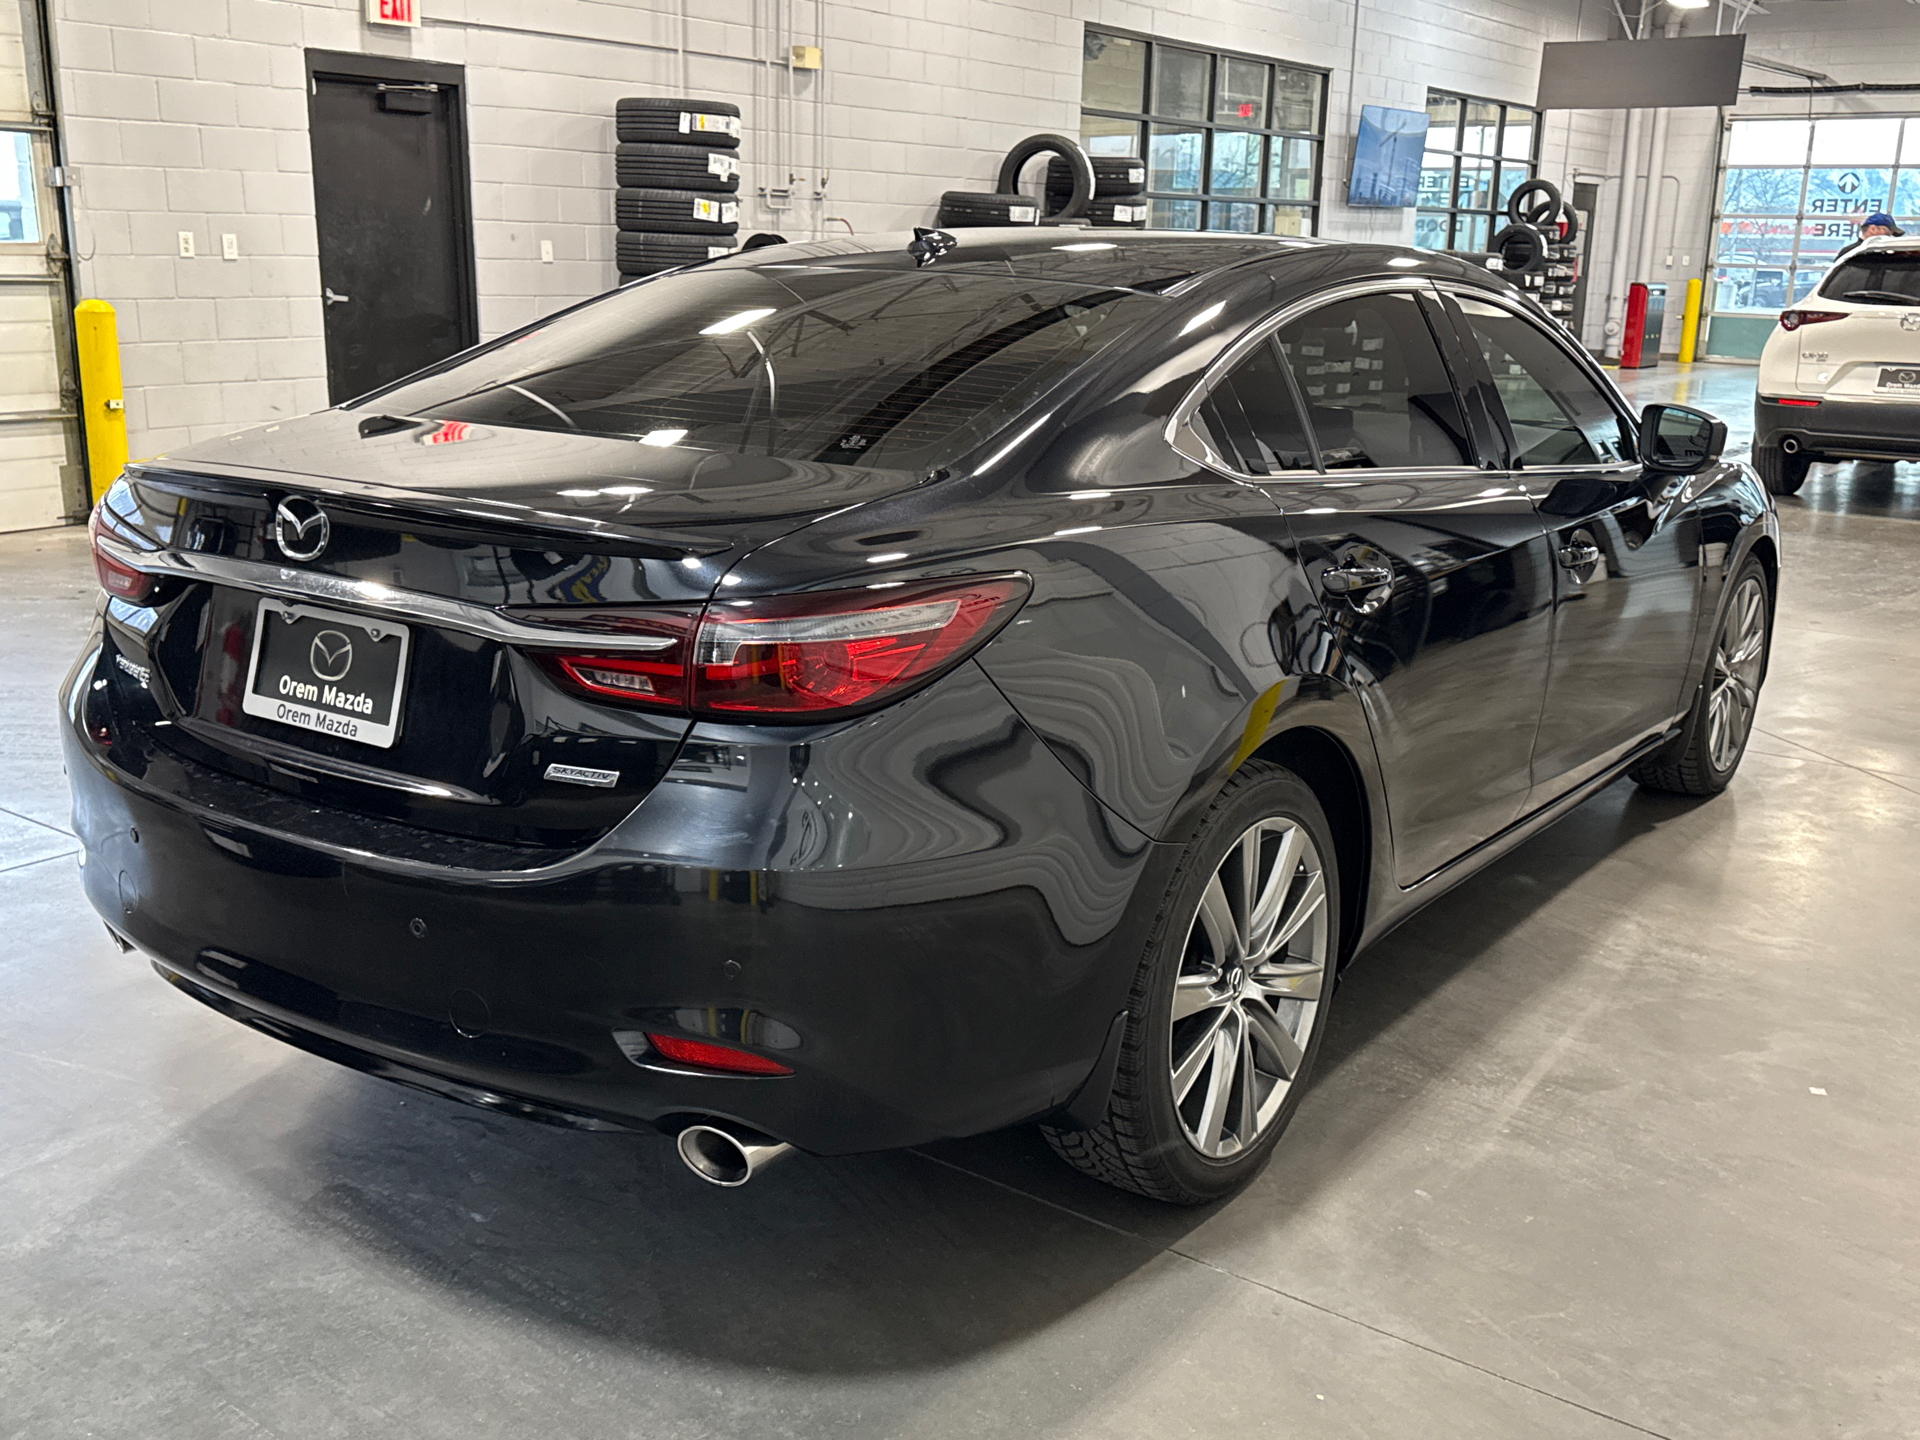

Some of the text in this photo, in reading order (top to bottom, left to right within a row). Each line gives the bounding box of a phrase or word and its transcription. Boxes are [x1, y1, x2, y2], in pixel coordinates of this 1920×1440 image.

[279, 675, 374, 715] Orem Mazda
[276, 703, 358, 738] Orem Mazda
[552, 767, 611, 780] SKYACTIV
